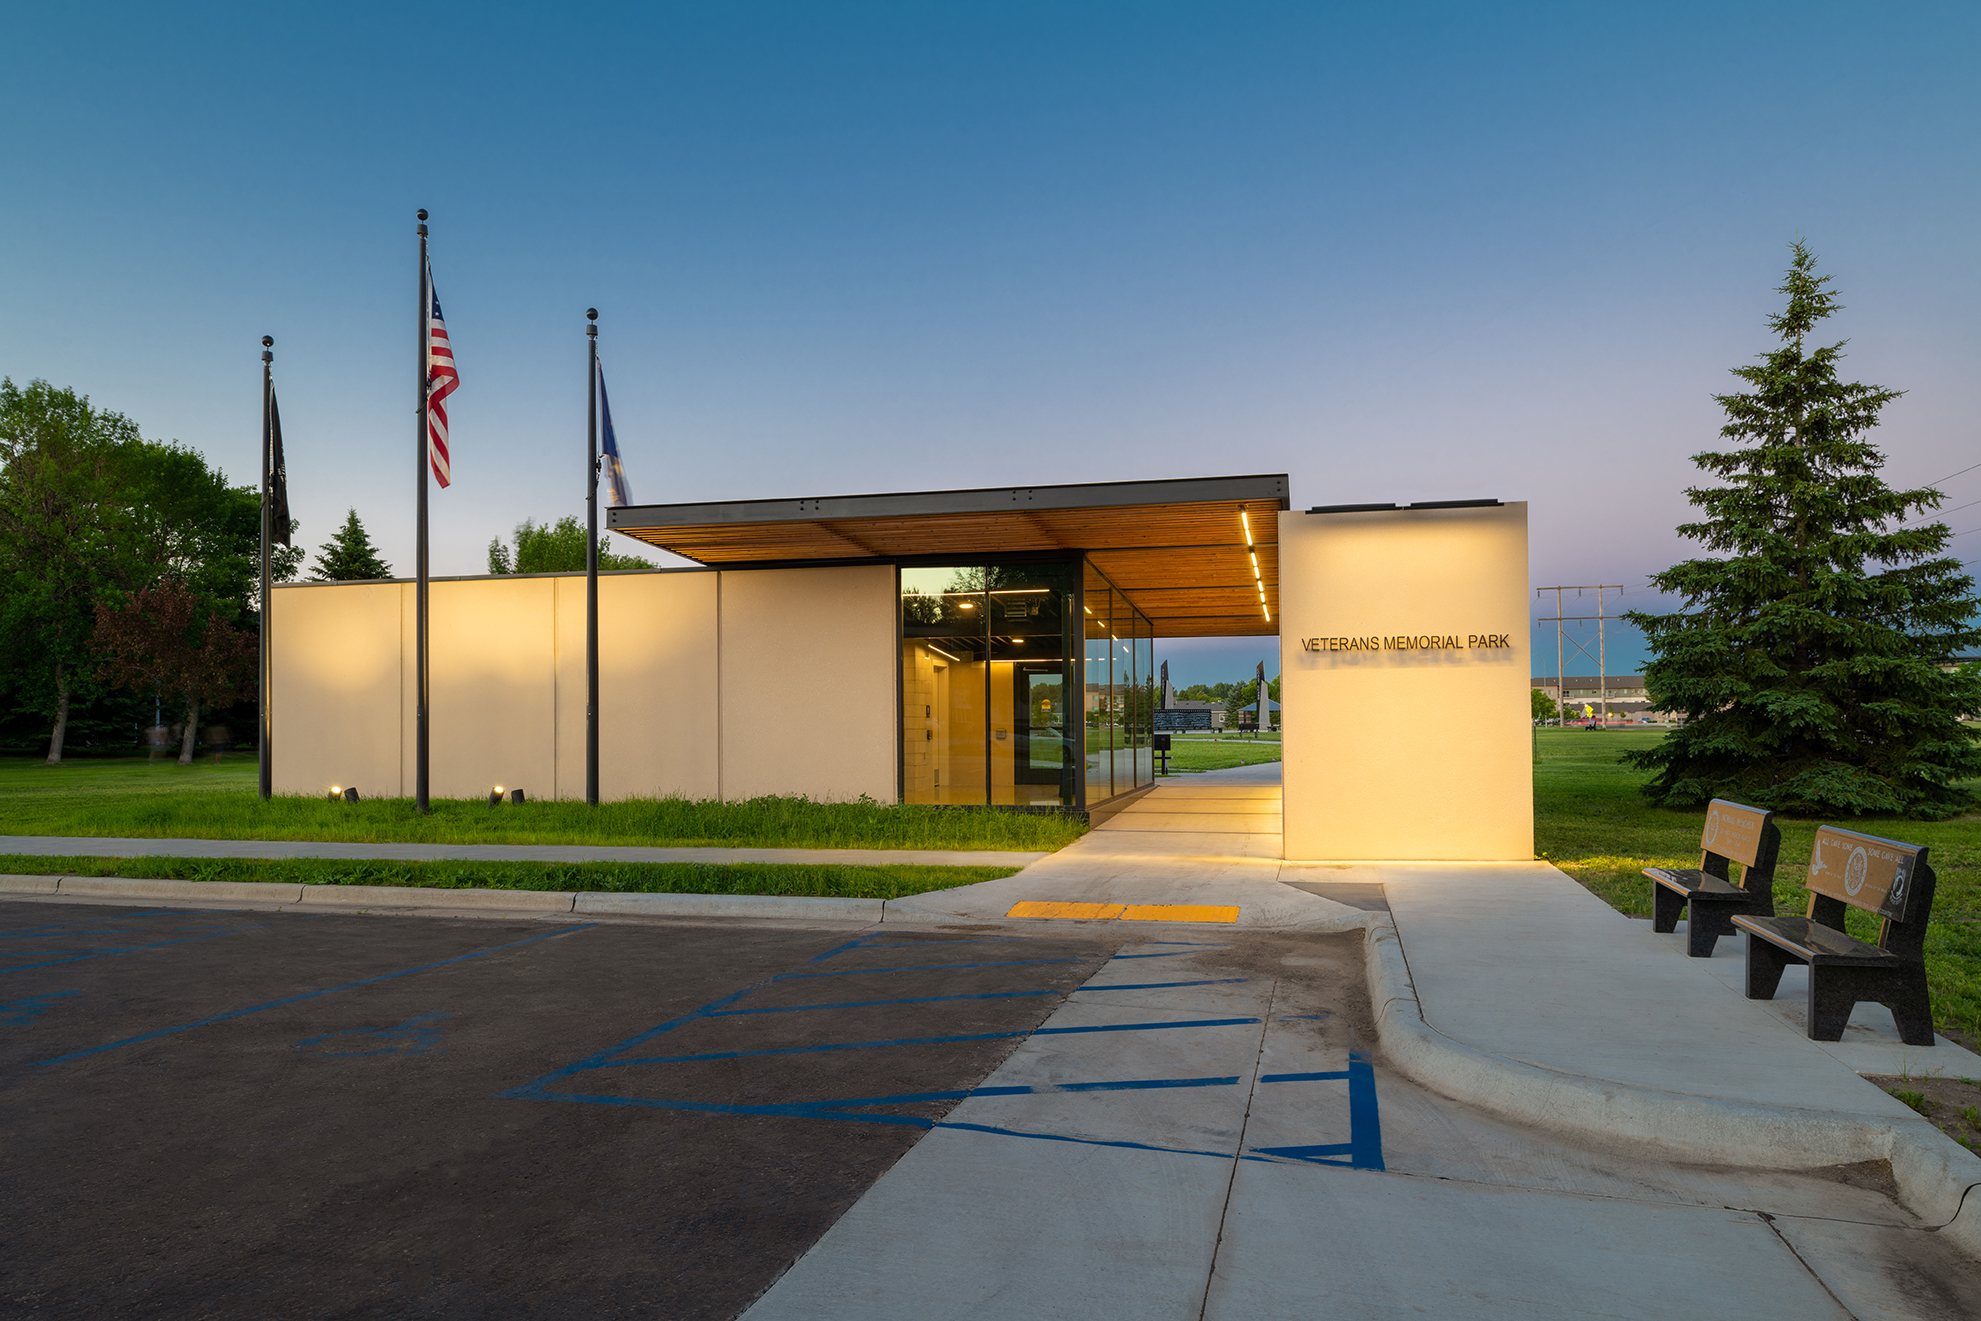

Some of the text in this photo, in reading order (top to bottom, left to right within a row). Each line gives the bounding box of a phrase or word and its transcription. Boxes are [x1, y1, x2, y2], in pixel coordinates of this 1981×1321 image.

[1301, 634, 1510, 652] VETERANS MEMORIAL PARK
[1822, 838, 1830, 846] ALL
[1867, 847, 1905, 865] SOME GAVE ALL
